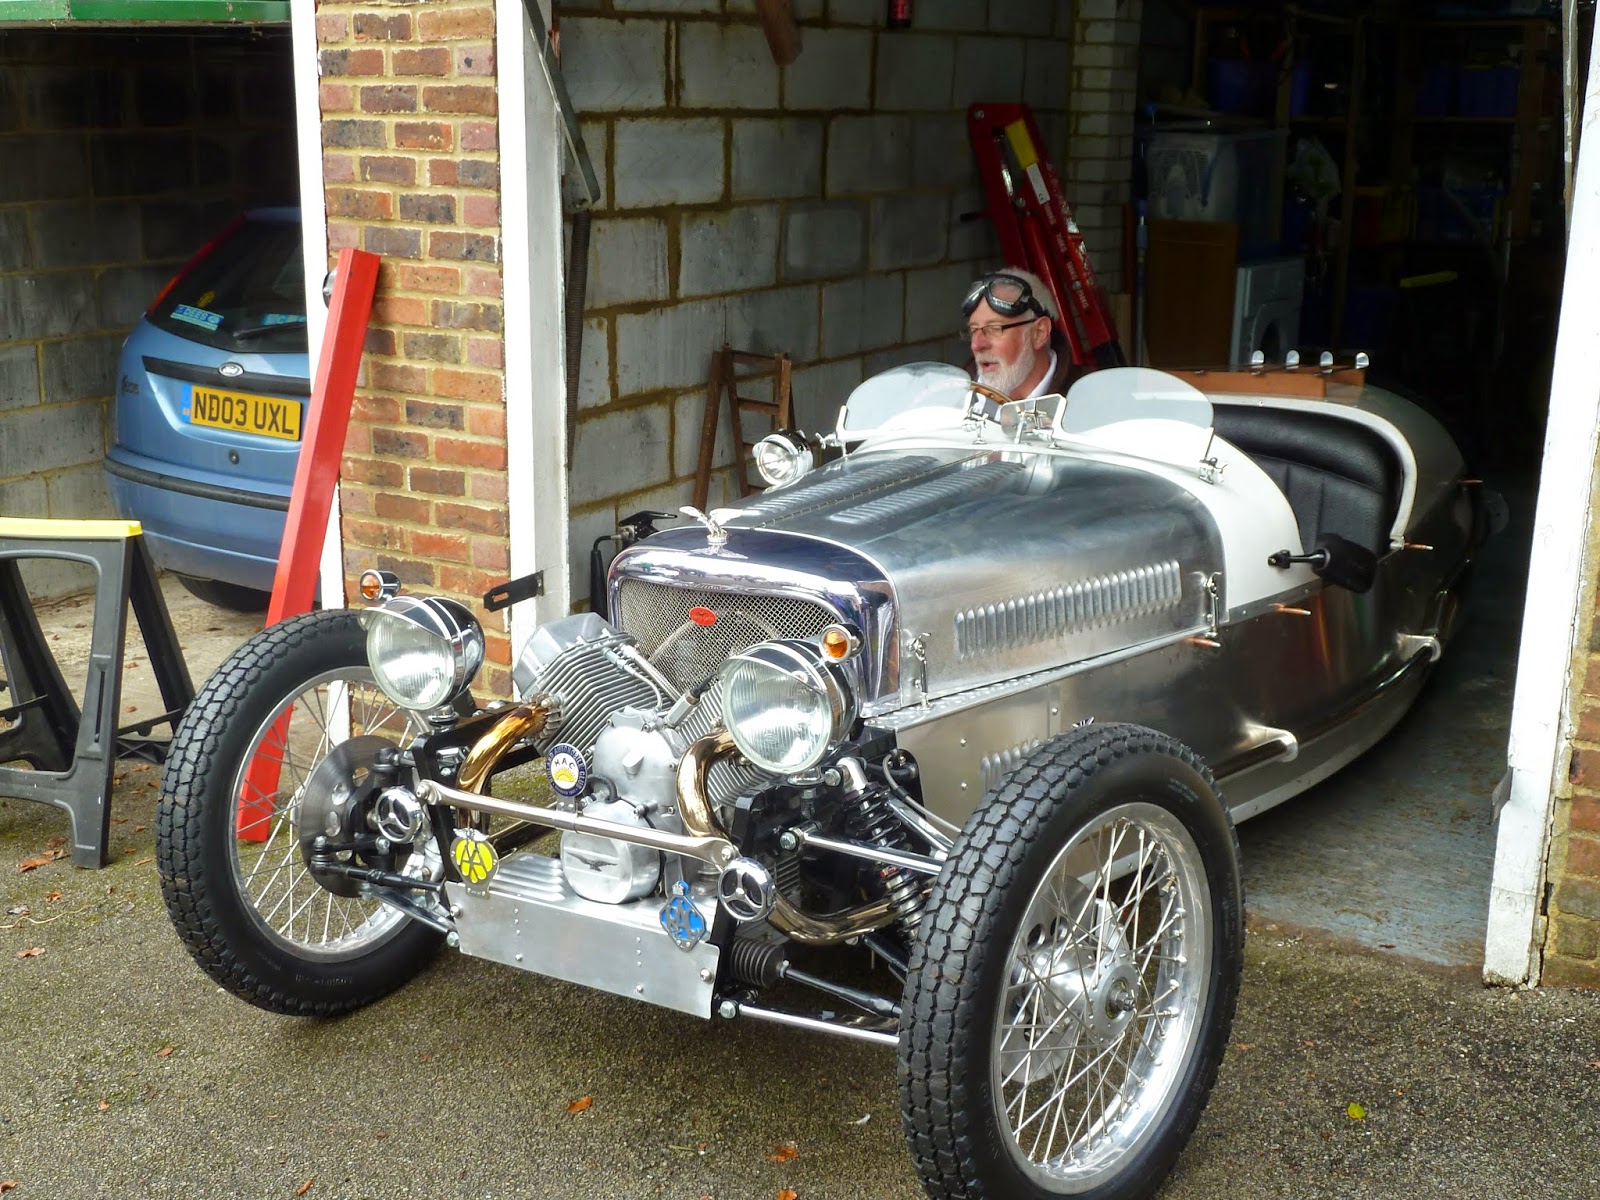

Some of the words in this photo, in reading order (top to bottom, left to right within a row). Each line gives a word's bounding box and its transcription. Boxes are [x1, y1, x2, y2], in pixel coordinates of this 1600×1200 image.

[194, 391, 248, 426] ND03
[254, 401, 294, 435] UXL
[576, 770, 586, 790] CLUB
[457, 838, 491, 883] AA
